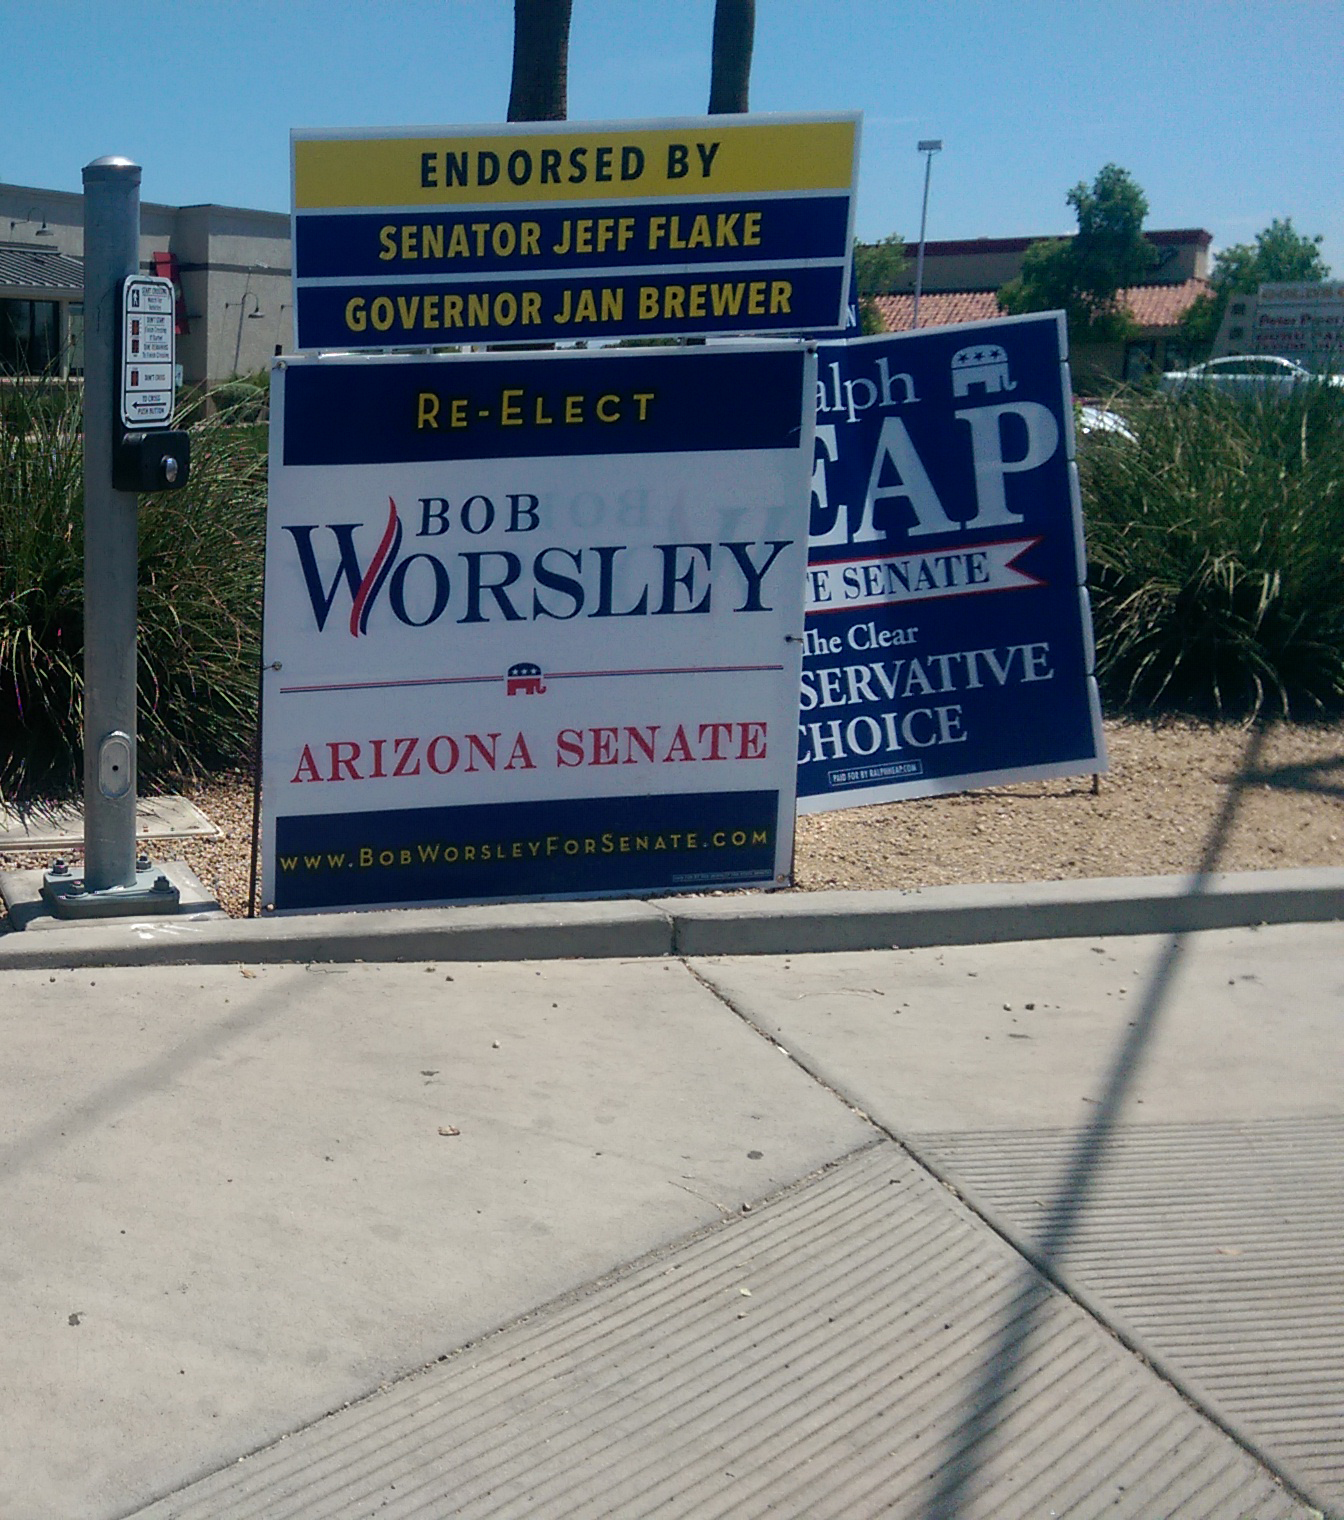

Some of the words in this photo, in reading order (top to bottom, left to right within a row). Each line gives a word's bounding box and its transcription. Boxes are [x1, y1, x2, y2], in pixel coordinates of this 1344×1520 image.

[420, 144, 645, 188] ENDORSED
[666, 142, 720, 180] BY
[378, 221, 541, 261] SENATOR
[553, 217, 635, 254] JEFF
[648, 212, 762, 251] FLAKE
[345, 291, 542, 333] GOVERNOR
[553, 287, 624, 325] JAN
[639, 280, 793, 320] BREWER
[815, 357, 922, 423] alph
[808, 400, 1059, 547] EAP
[416, 493, 540, 536] BOB
[281, 497, 794, 638] WORSLEY
[842, 550, 991, 600] SENATE
[848, 621, 919, 652] Clear
[800, 642, 1054, 712] SERVATIVE
[290, 731, 537, 784] ARIZONA
[556, 722, 768, 768] SENATE
[833, 773, 846, 782] PAID
[847, 771, 859, 780] FOR
[860, 770, 868, 779] BY
